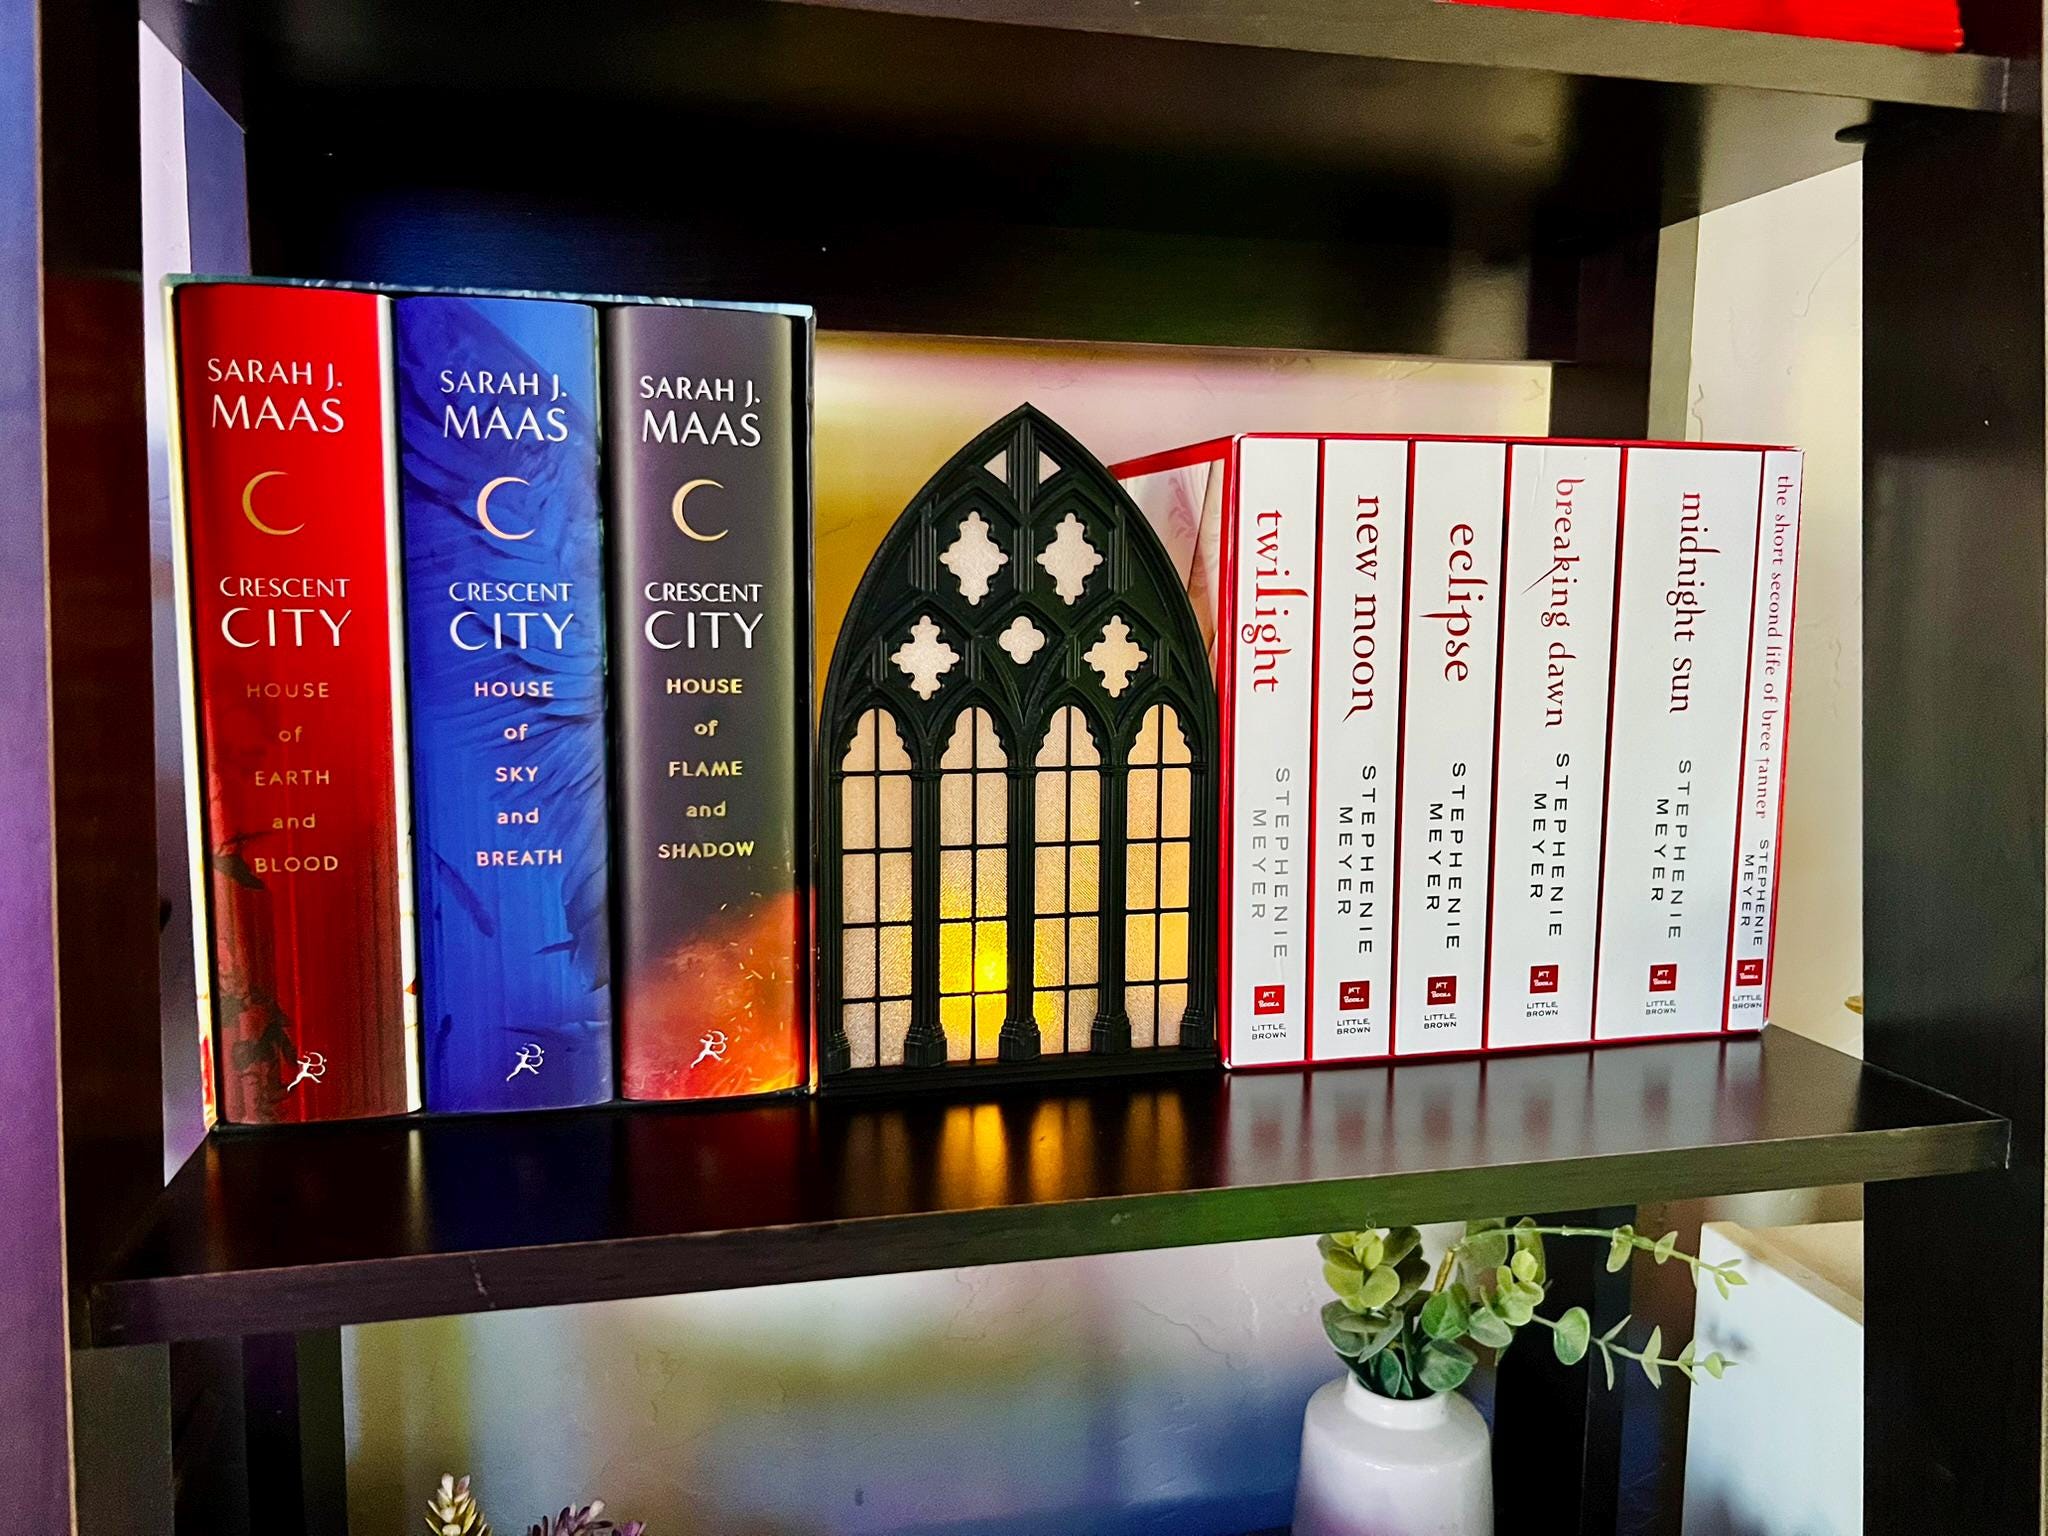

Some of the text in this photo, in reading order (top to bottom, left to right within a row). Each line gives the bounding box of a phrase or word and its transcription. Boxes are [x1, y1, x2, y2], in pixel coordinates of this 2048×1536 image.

[207, 358, 343, 392] SARAH J.
[439, 369, 567, 402] SARAH J.
[639, 375, 761, 408] SARAH J.
[212, 394, 344, 433] MAAS
[444, 404, 569, 442] MAAS
[642, 408, 761, 447] MAAS
[1776, 475, 1794, 505] the
[1772, 514, 1791, 565] short
[219, 576, 350, 598] CRESCENT
[449, 582, 574, 602] CRESCENT
[644, 581, 763, 603] CRESCENT
[1240, 508, 1309, 693] twilight
[1419, 523, 1489, 682] eclipse
[1521, 477, 1586, 728] breaking dawn
[1665, 492, 1721, 714] midnight sun
[1341, 495, 1380, 724] new moon
[1766, 572, 1784, 638] second
[221, 607, 352, 648] CITY
[449, 611, 574, 651] CITY
[644, 610, 764, 650] CITY
[1763, 645, 1783, 677] life
[247, 681, 329, 699] HOUSE
[474, 680, 555, 698] HOUSE
[666, 678, 743, 695] HOUSE
[1763, 682, 1778, 703] of
[278, 725, 303, 743] of
[503, 723, 529, 741] of
[693, 719, 719, 737] of
[1759, 709, 1778, 752] bree
[255, 769, 330, 787] EARTH
[495, 765, 539, 783] SKY
[669, 760, 743, 778] FLAME
[272, 813, 316, 830] and
[497, 807, 539, 825] and
[685, 800, 726, 818] and
[476, 848, 562, 867] BREATH
[658, 840, 755, 859] SHADOW
[1337, 806, 1354, 915] MEYER
[1358, 765, 1377, 954] STEPHENIE
[1426, 803, 1444, 910] MEYER
[1446, 762, 1467, 949] STEPHENIE
[1529, 793, 1548, 898] MEYER
[1548, 753, 1570, 937] STEPHENIE
[1650, 798, 1670, 901] MEYER
[1667, 759, 1692, 939] STEPHENIE
[254, 855, 339, 873] BLOOD
[1251, 809, 1267, 919] MEYER
[1273, 767, 1291, 959] STEPHENIE
[1739, 853, 1756, 927] MEYER
[1752, 839, 1770, 947] STEPHENIE
[1423, 1022, 1457, 1030] BROWN
[1526, 1010, 1559, 1018] BROWN
[1645, 1008, 1677, 1016] BROWN
[1251, 1032, 1287, 1040] BROWN
[1336, 1027, 1371, 1035] BROWN
